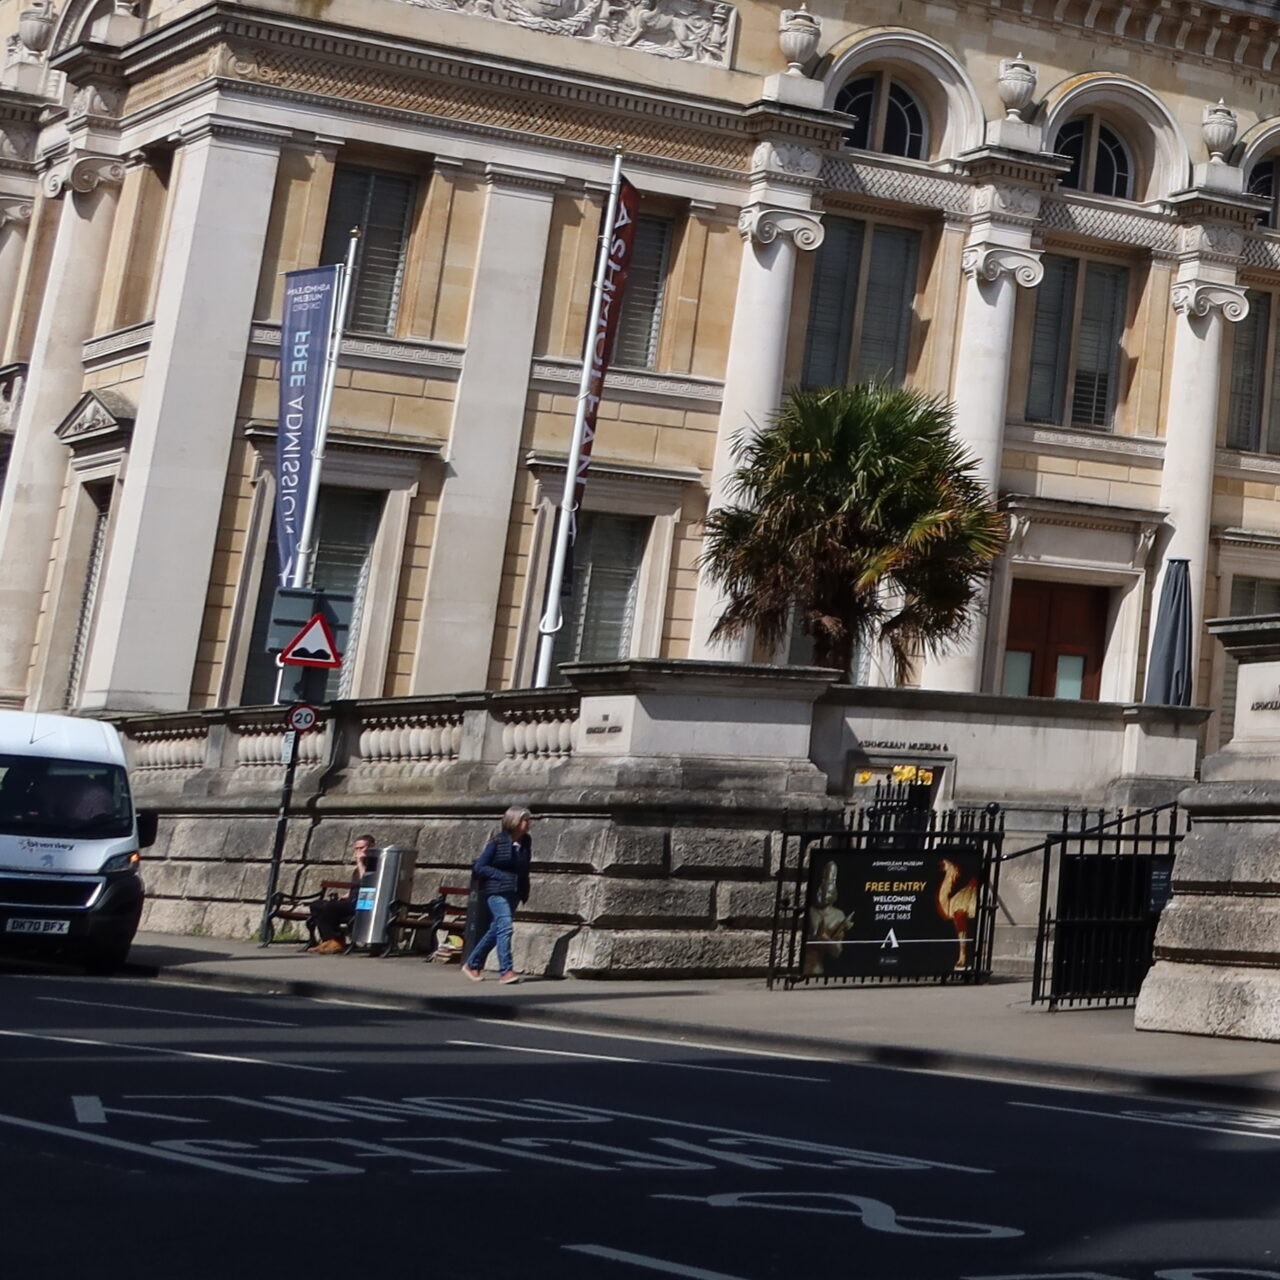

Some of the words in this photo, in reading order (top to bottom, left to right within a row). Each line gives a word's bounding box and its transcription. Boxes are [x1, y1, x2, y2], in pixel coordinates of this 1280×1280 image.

[294, 712, 313, 725] 20
[857, 740, 906, 750] ASHMOLEAN
[908, 742, 941, 751] MUSEUM
[864, 881, 892, 892] FREE
[893, 881, 927, 892] ENTRY
[873, 895, 916, 903] WELCOMING
[875, 904, 912, 912] EVERYONE
[874, 912, 895, 921] SINCE
[11, 920, 41, 933] DK70
[43, 921, 66, 933] BFX
